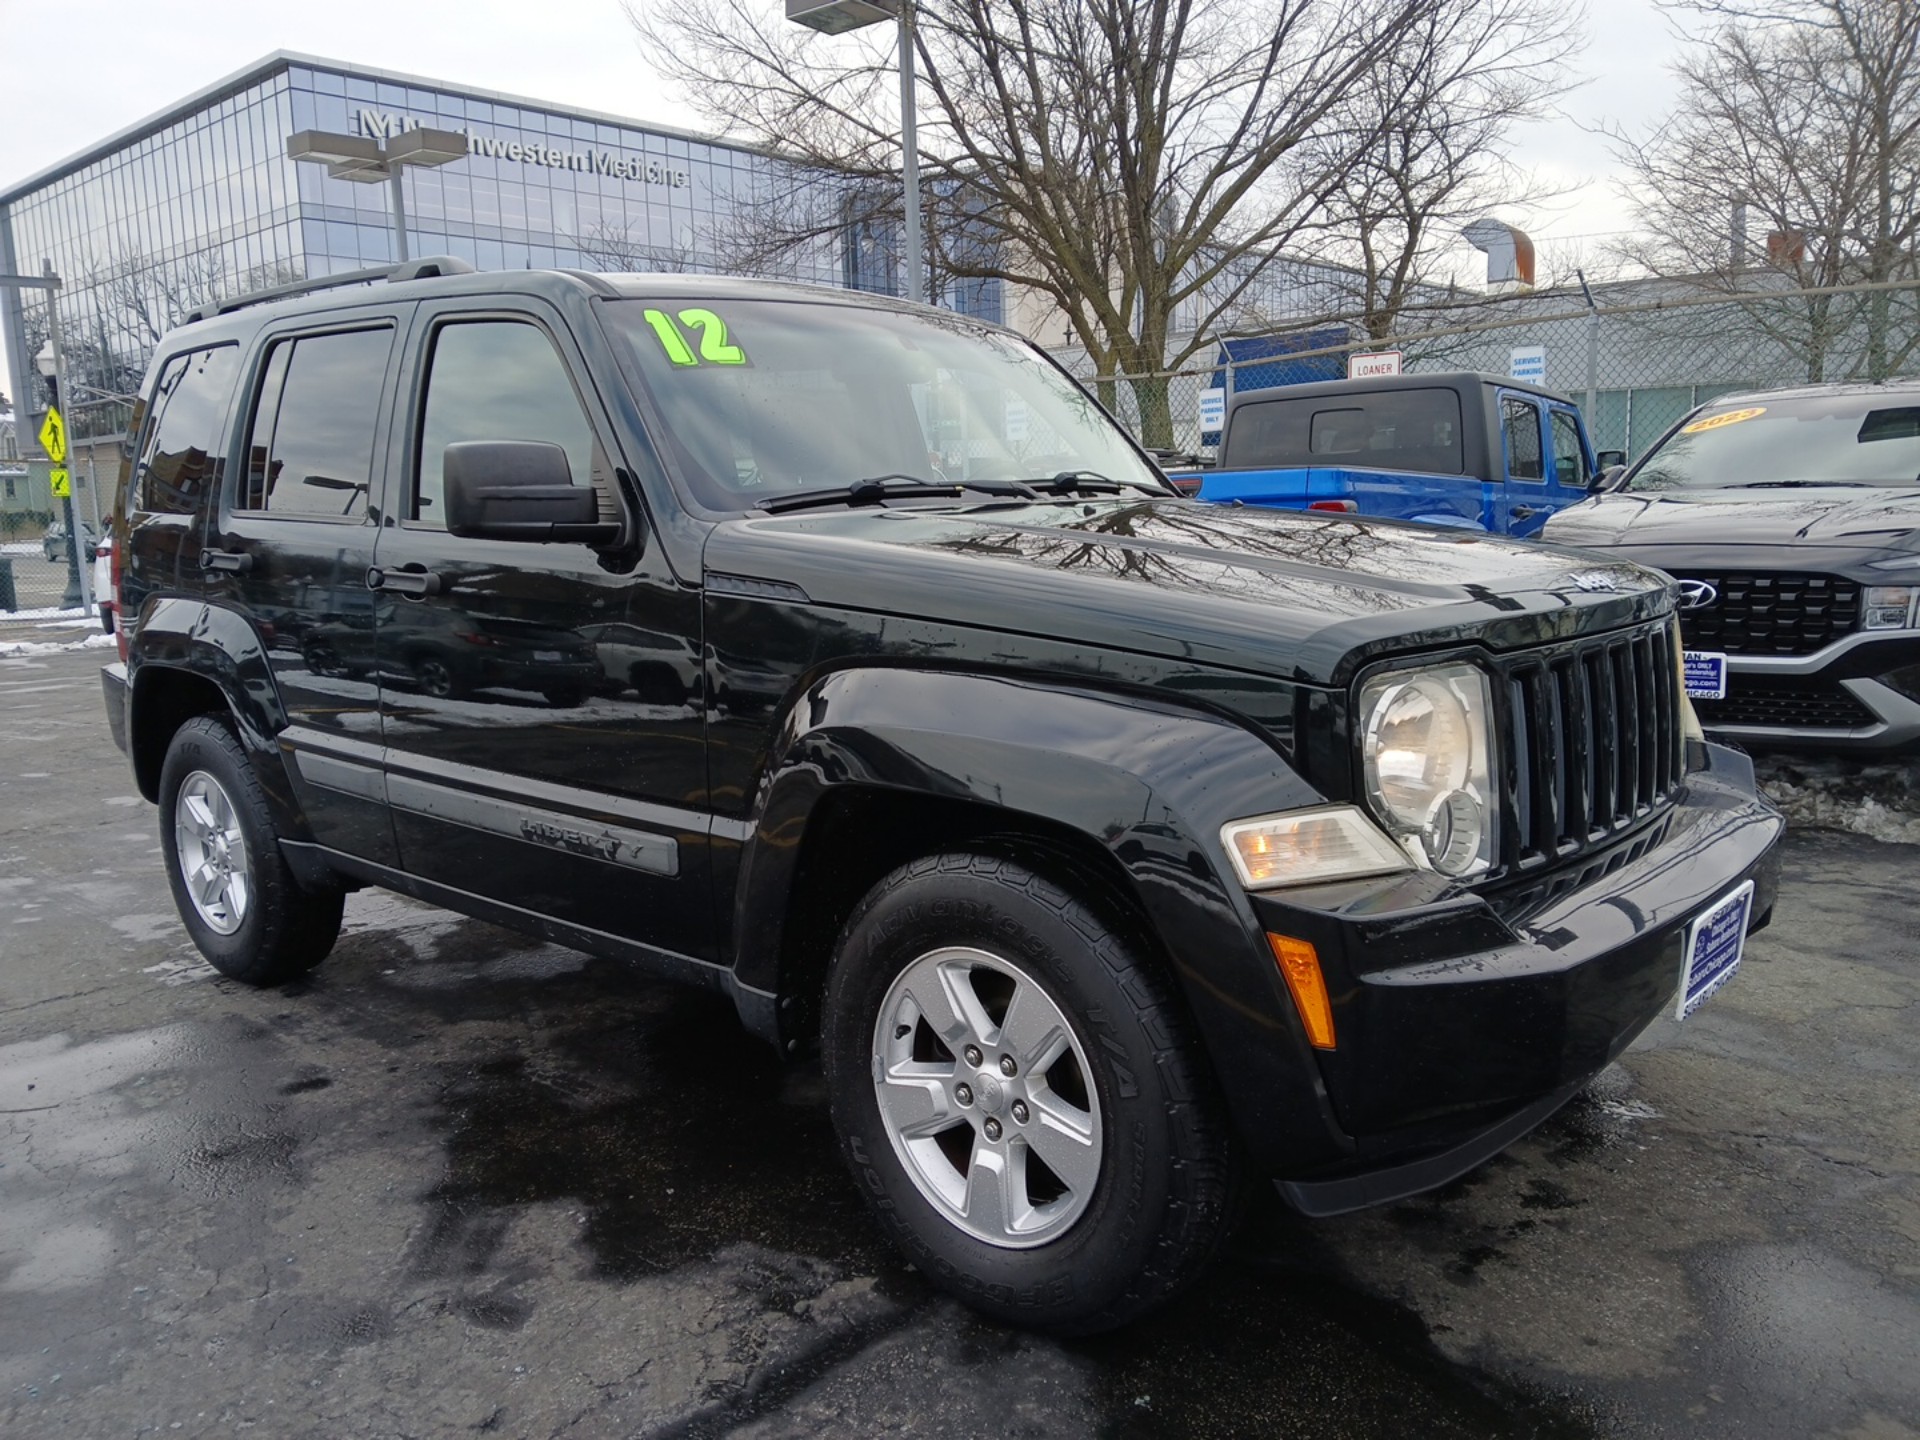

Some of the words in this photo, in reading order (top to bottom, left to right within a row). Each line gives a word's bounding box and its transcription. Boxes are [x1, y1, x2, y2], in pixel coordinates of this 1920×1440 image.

[590, 149, 690, 188] Medicine
[643, 308, 748, 366] 12
[1513, 356, 1542, 366] SERVICE
[1357, 363, 1393, 377] LOANER
[1512, 367, 1543, 377] PARKING
[1200, 397, 1222, 405] SERVICE
[1200, 406, 1224, 414] PARKING
